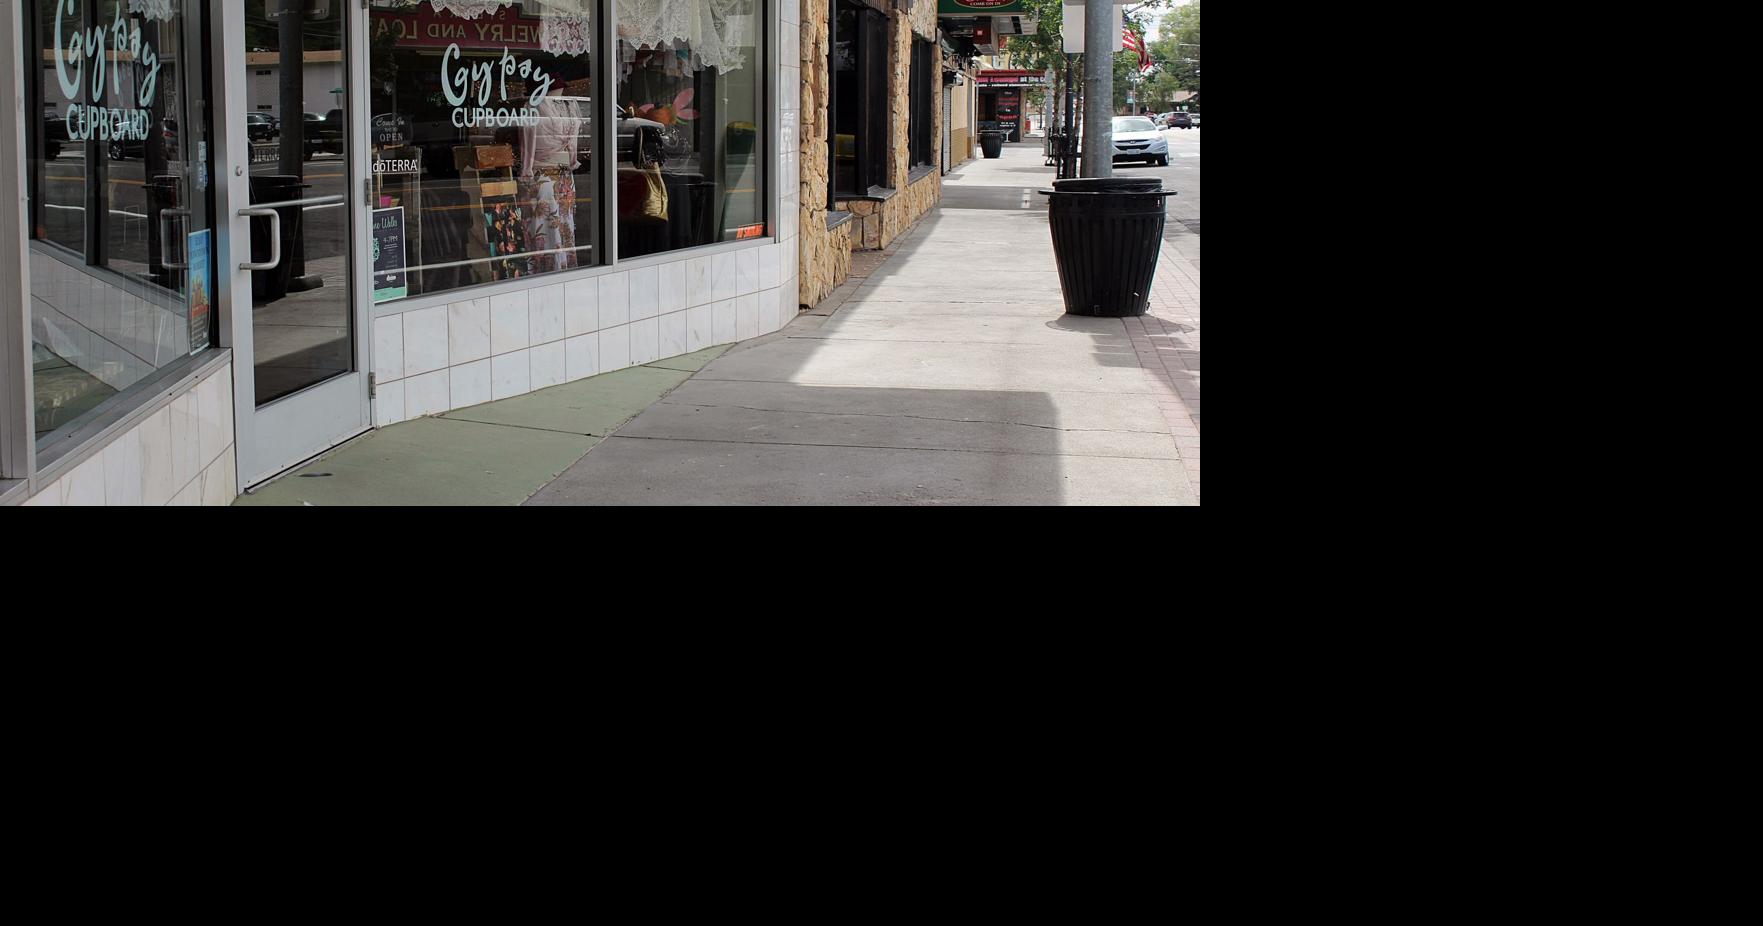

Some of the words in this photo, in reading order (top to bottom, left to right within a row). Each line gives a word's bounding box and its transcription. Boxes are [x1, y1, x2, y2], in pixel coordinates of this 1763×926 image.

[66, 103, 149, 141] CUPBOARD
[452, 107, 540, 128] CUPBOARD
[380, 132, 403, 142] OPEN
